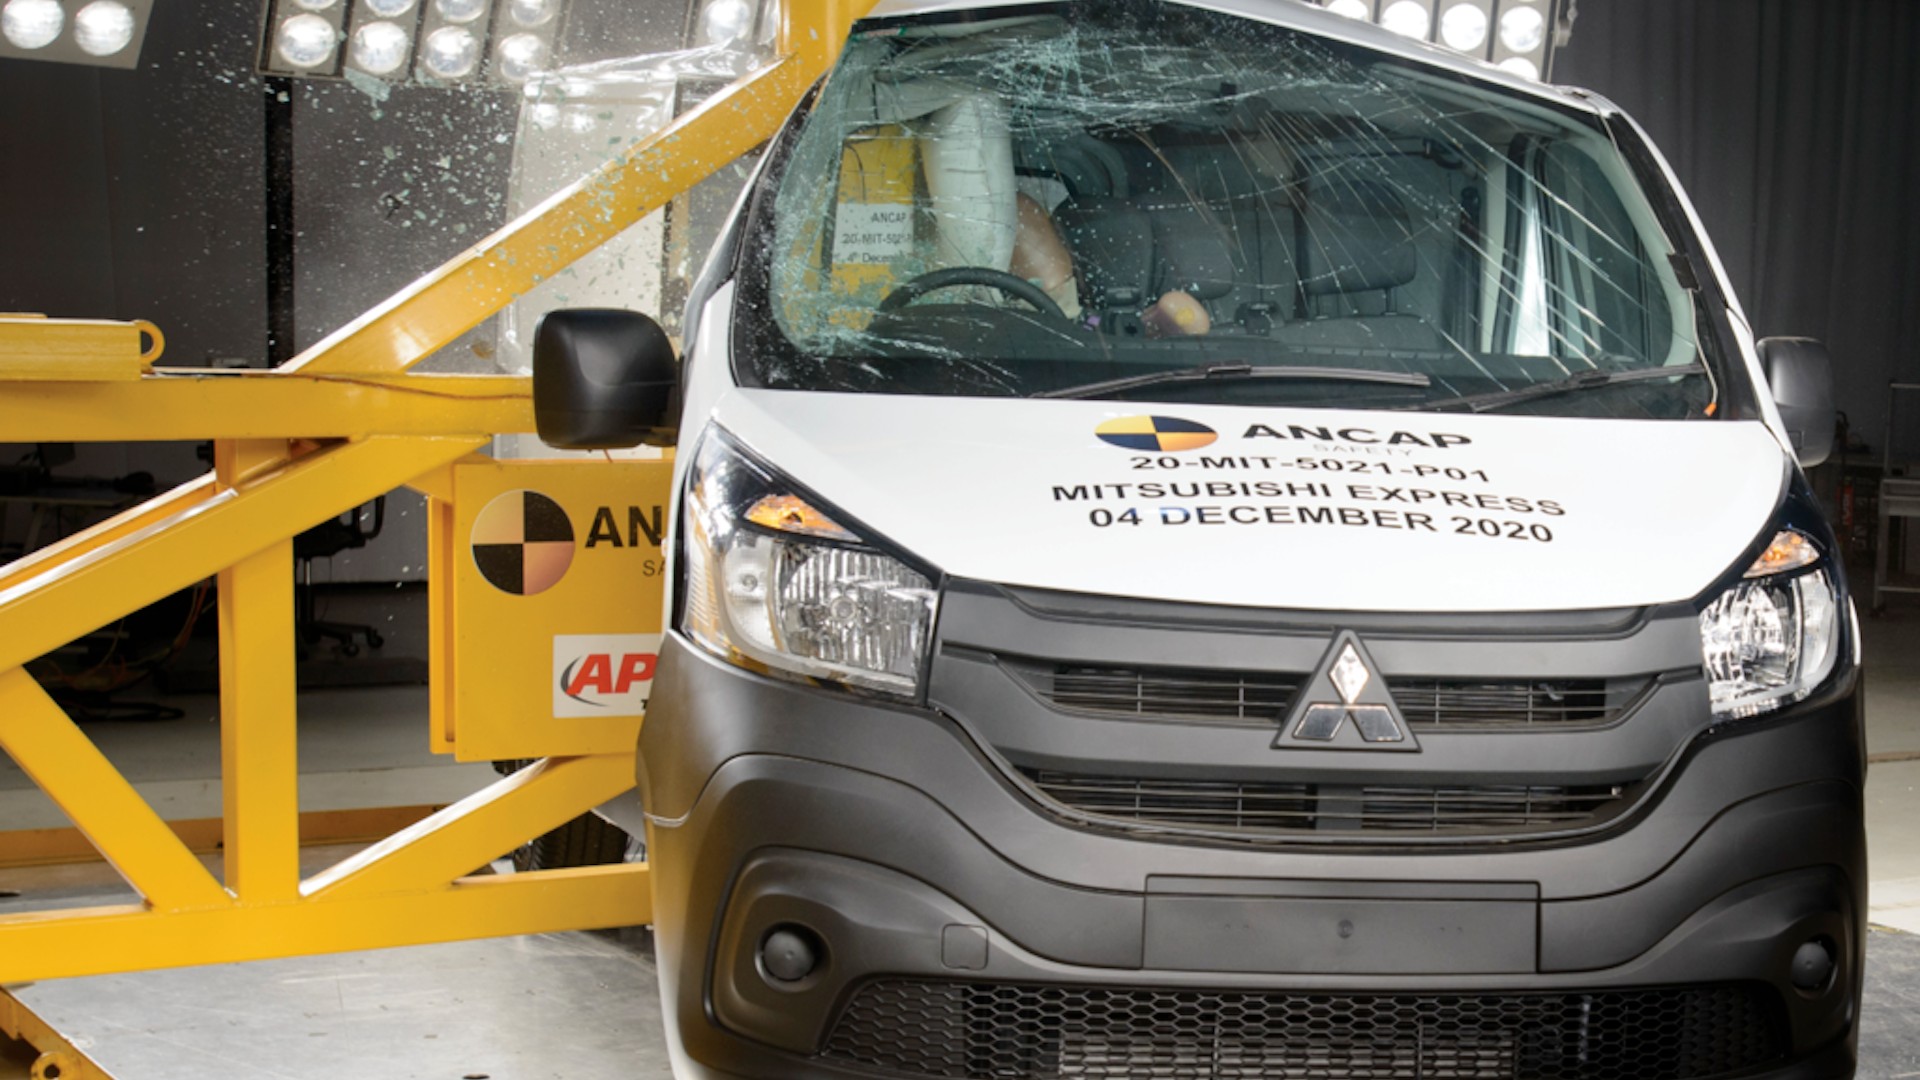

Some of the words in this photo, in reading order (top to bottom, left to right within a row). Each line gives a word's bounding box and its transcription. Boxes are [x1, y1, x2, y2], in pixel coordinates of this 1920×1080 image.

[1242, 424, 1473, 448] ANCAP
[1313, 444, 1412, 456] SAFETY
[1130, 456, 1490, 483] 20-MIT-5021-P01
[1052, 482, 1332, 501] MITSUBISHI
[1347, 484, 1566, 516] EXPRESS
[1089, 507, 1143, 527] 04
[1159, 506, 1438, 532] DECEMBER
[1450, 516, 1554, 543] 2020
